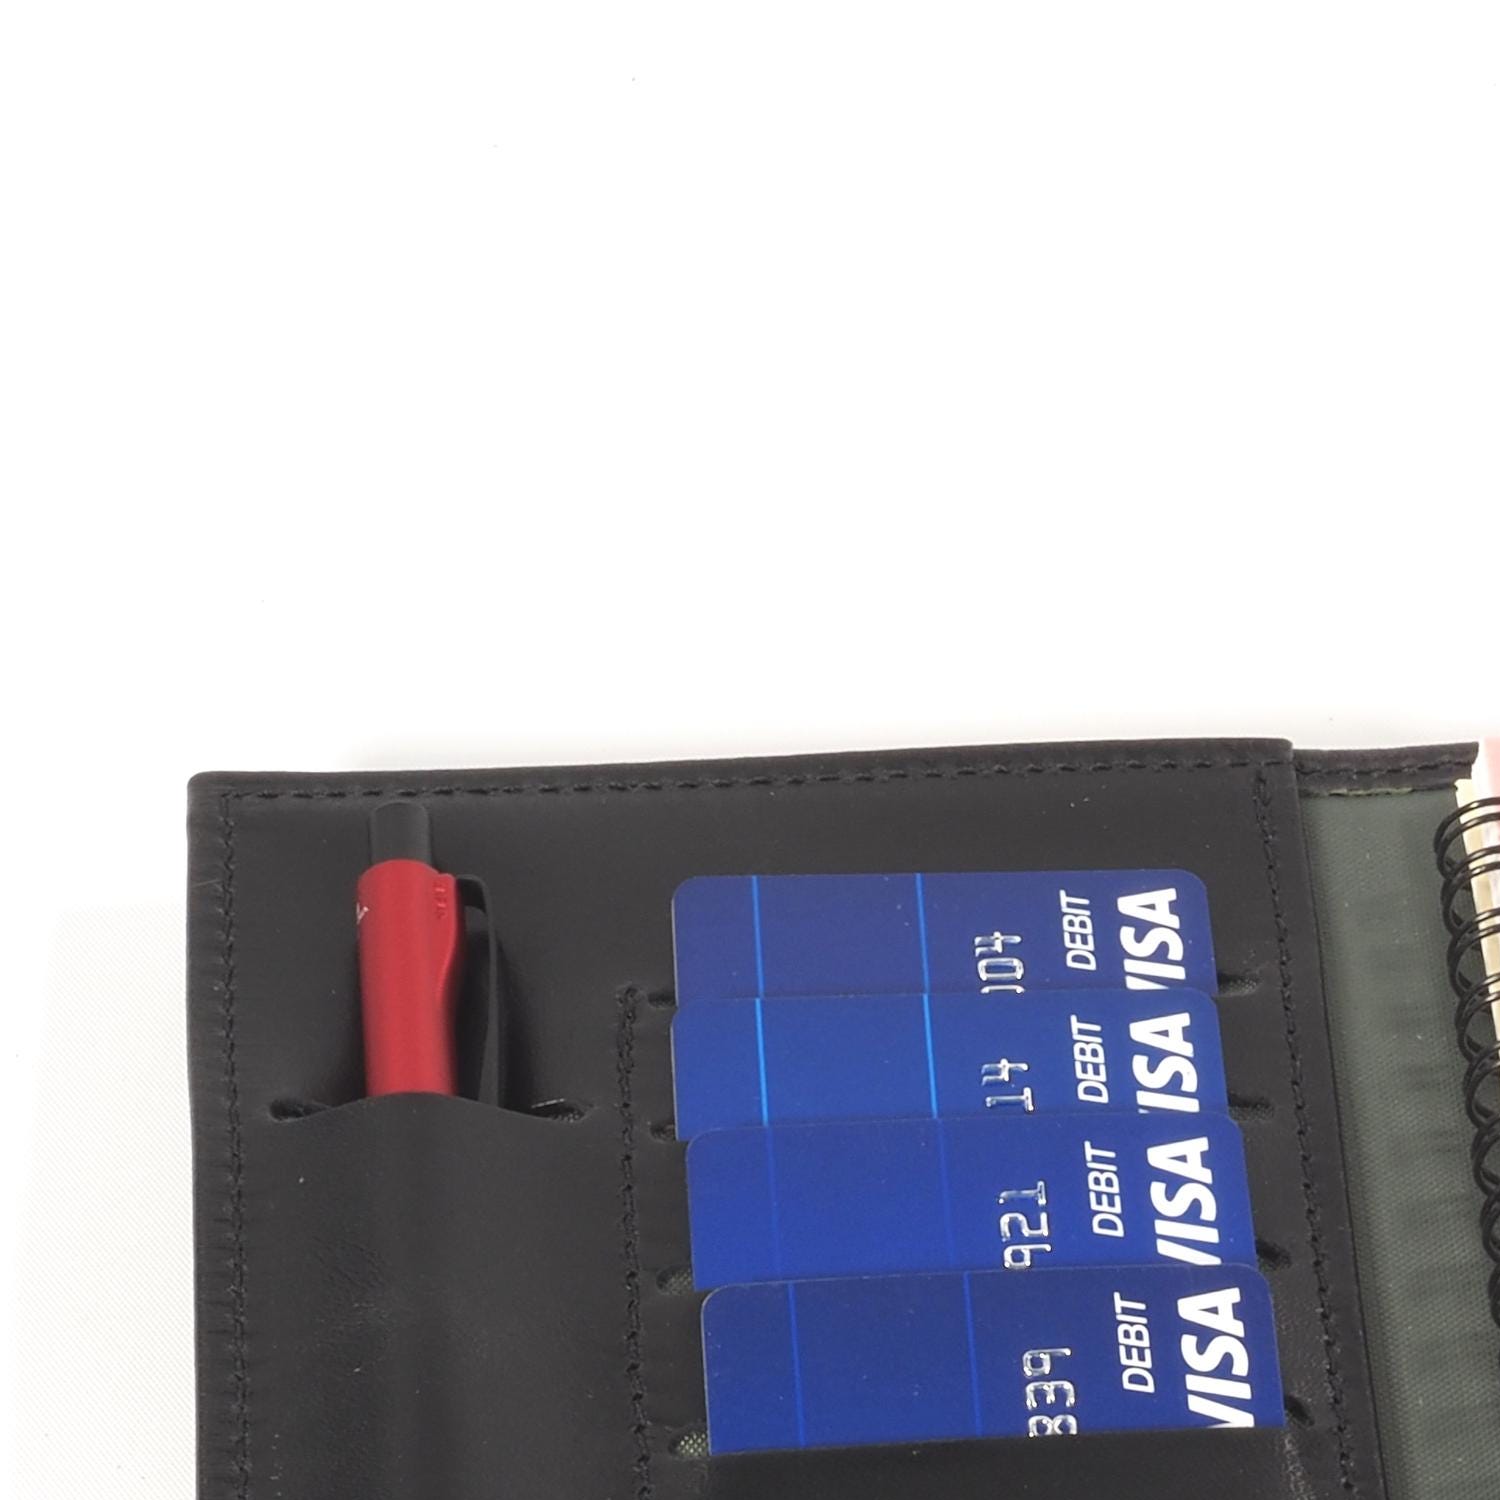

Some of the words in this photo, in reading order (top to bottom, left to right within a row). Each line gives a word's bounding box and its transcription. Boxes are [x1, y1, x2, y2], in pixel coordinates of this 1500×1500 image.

[1059, 889, 1097, 971] DEBIT
[1117, 887, 1186, 990] ISA
[1070, 1014, 1109, 1104] DEBIT
[1129, 1012, 1200, 1113] ISA
[1084, 1140, 1124, 1237] DEBIT
[1113, 1291, 1155, 1393] DEBIT
